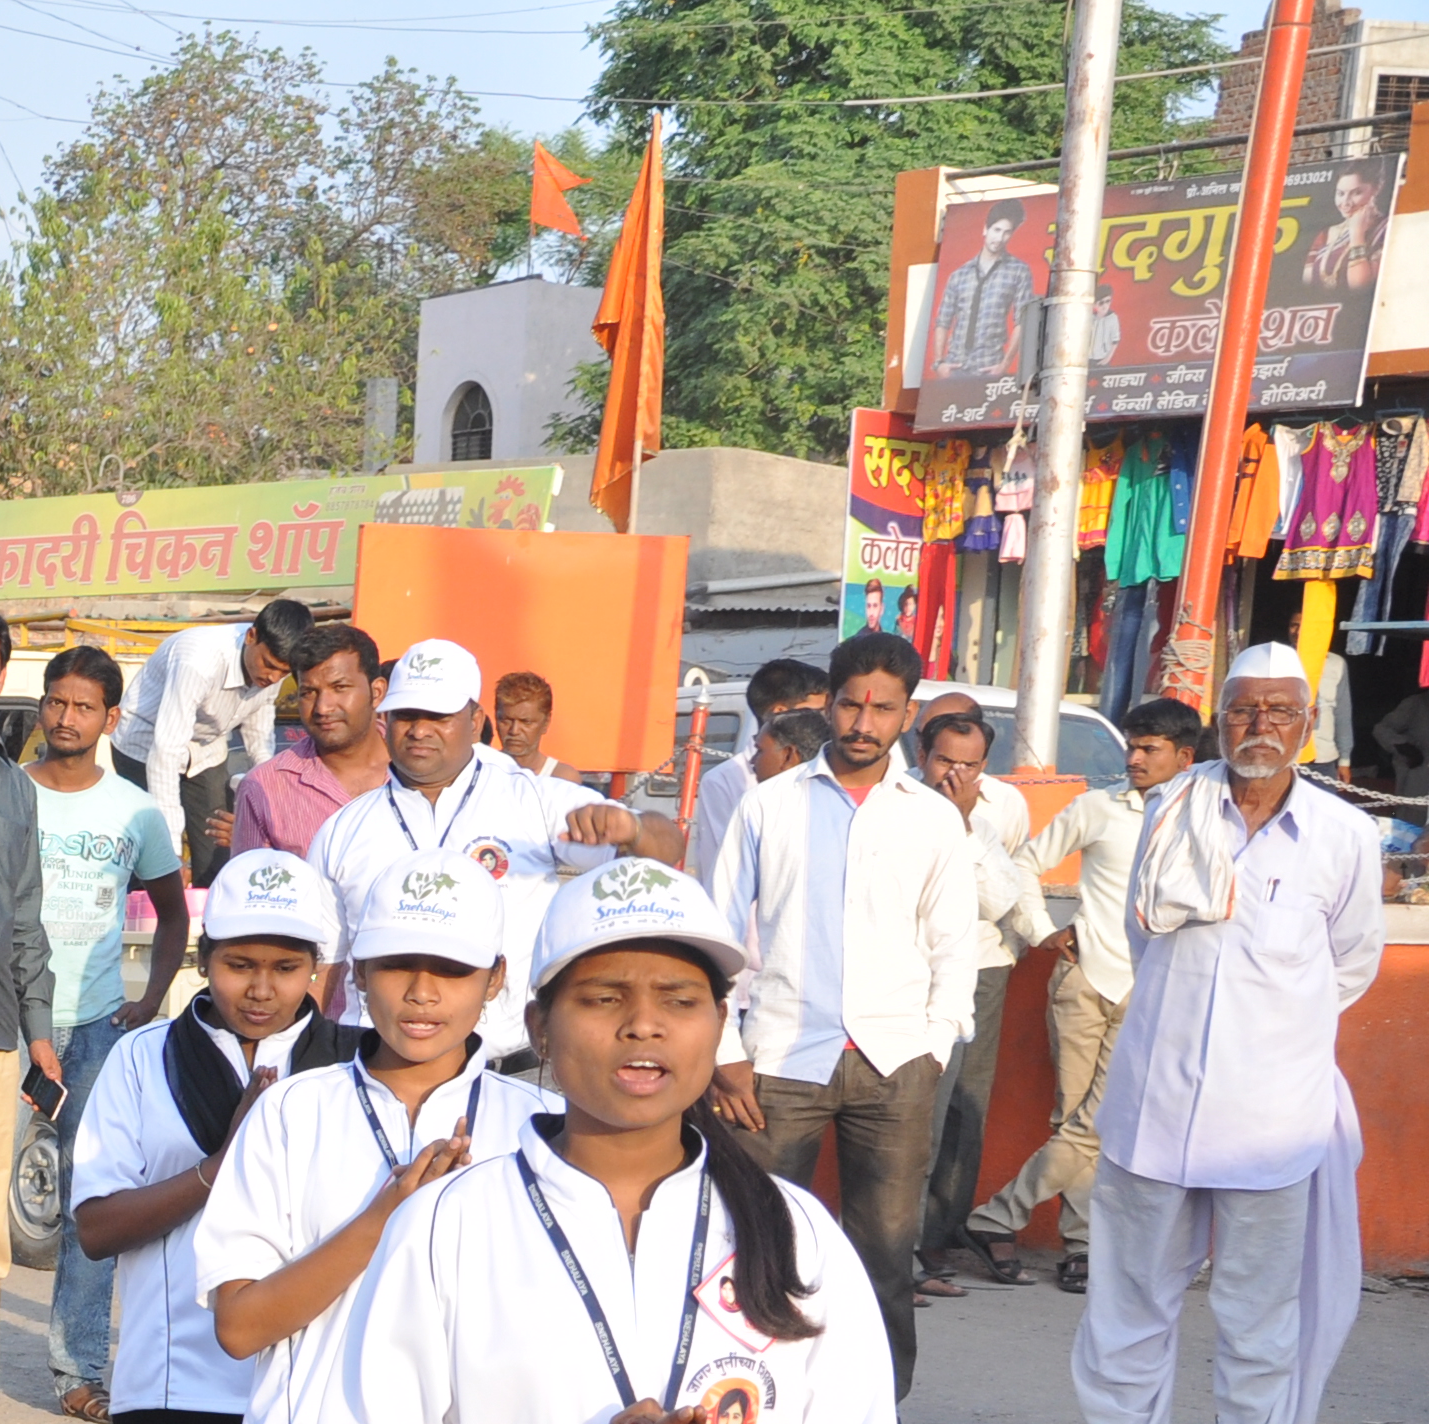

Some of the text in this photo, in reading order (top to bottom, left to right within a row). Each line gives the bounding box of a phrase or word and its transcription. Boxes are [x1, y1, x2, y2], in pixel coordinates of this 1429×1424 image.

[1147, 299, 1342, 354] कलेशन
[104, 508, 239, 585] चिकन
[246, 500, 346, 577] शॉप
[61, 868, 104, 880] JUNIOR
[57, 881, 93, 892] SKIPER
[245, 890, 298, 906] Snehalaya
[397, 899, 457, 921] Snehalaya
[596, 899, 685, 921] Snehalaya
[686, 1363, 712, 1393] जागर
